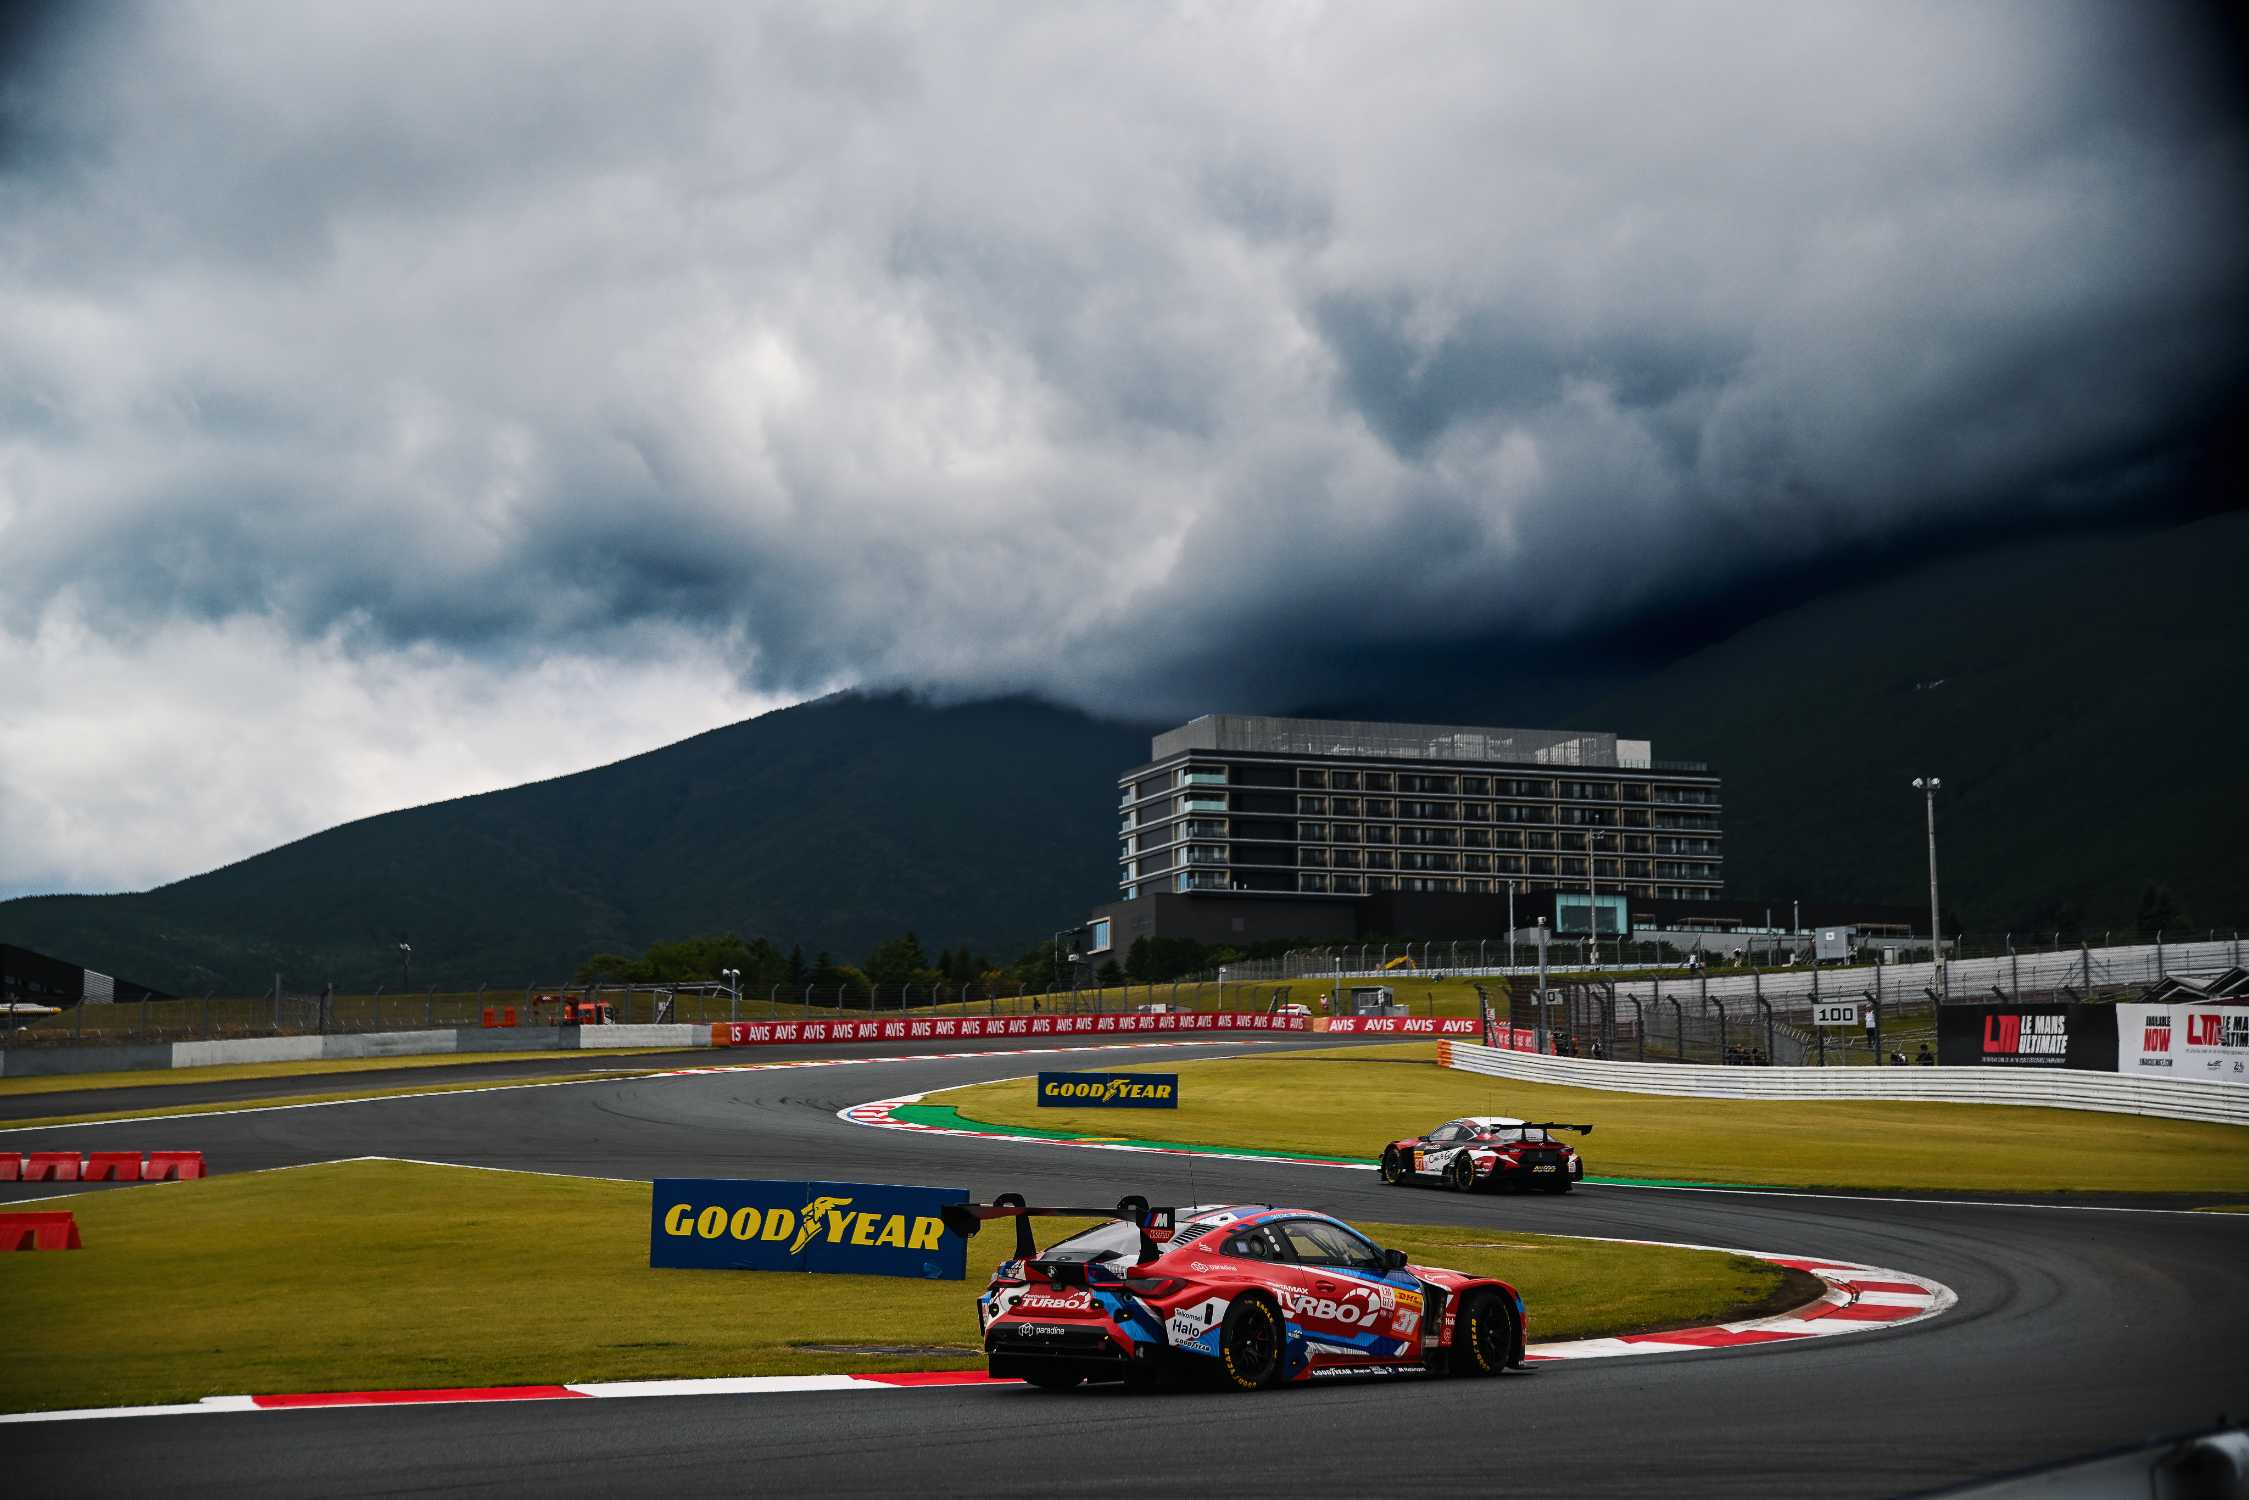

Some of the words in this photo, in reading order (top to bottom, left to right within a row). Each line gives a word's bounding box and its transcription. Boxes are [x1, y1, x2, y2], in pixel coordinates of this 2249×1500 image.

[1818, 1007, 1853, 1021] 100
[749, 1026, 770, 1041] AVIS
[774, 1025, 798, 1040] AVIS
[803, 1024, 826, 1040] AVIS
[832, 1023, 854, 1039] AVIS
[858, 1023, 878, 1038] AVIS
[885, 1022, 905, 1037] AVIS
[911, 1022, 931, 1036] AVIS
[935, 1021, 955, 1035] AVIS
[961, 1020, 980, 1035] AVIS
[986, 1020, 1005, 1034] AVIS
[1009, 1019, 1026, 1033] AVIS
[1032, 1019, 1050, 1032] AVIS
[1056, 1018, 1073, 1031] AVIS
[1075, 1017, 1092, 1030] AVIS
[1097, 1017, 1115, 1030] AVIS
[1119, 1017, 1135, 1029] AVIS
[1139, 1016, 1155, 1029] AVIS
[1159, 1016, 1175, 1028] AVIS
[1179, 1015, 1195, 1028] AVIS
[1197, 1015, 1212, 1028] AVIS
[1218, 1015, 1232, 1027] AVIS
[1236, 1015, 1251, 1028] AVIS
[1253, 1015, 1268, 1028] AVIS
[1271, 1016, 1286, 1029] AVIS
[1289, 1018, 1304, 1030] AVIS
[1328, 1019, 1356, 1032] AVIS
[1364, 1019, 1395, 1031] AVIS
[1403, 1019, 1434, 1032] AVIS
[1442, 1020, 1474, 1033] AVIS
[2021, 1015, 2033, 1034] LE
[2034, 1015, 2066, 1034] MANS
[2018, 1035, 2068, 1054] ULTIMATE
[2143, 1028, 2172, 1052] NOW
[1154, 1213, 1168, 1228] M
[1022, 1298, 1080, 1309] TURBO
[1272, 1288, 1360, 1323] TURBO
[1172, 1319, 1201, 1338] Halo
[1392, 1308, 1419, 1335] 31
